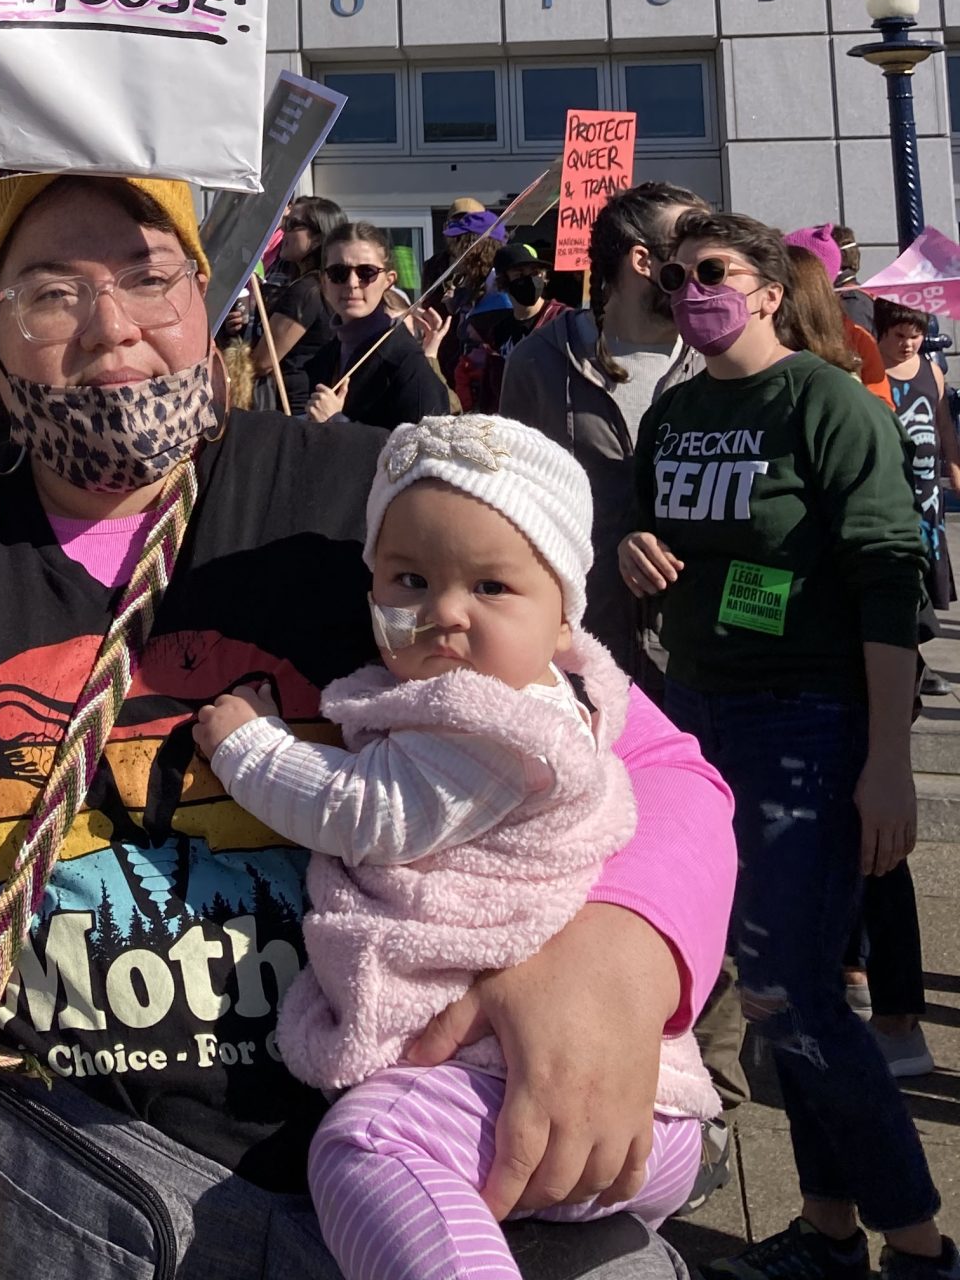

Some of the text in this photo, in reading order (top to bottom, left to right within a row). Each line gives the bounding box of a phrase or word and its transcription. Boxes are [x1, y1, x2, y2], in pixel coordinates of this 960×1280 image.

[568, 115, 634, 143] PROTECT
[567, 145, 623, 171] QUEER
[564, 174, 629, 199] & TRANS
[560, 204, 600, 230] FAMI
[676, 429, 766, 456] FECKIN
[654, 460, 769, 521] EEJIT
[732, 568, 764, 588] LEGAL
[728, 583, 782, 607] ABORTION
[726, 597, 783, 622] NATIONWIDE!
[47, 1043, 168, 1077] Choice
[193, 1033, 256, 1068] For
